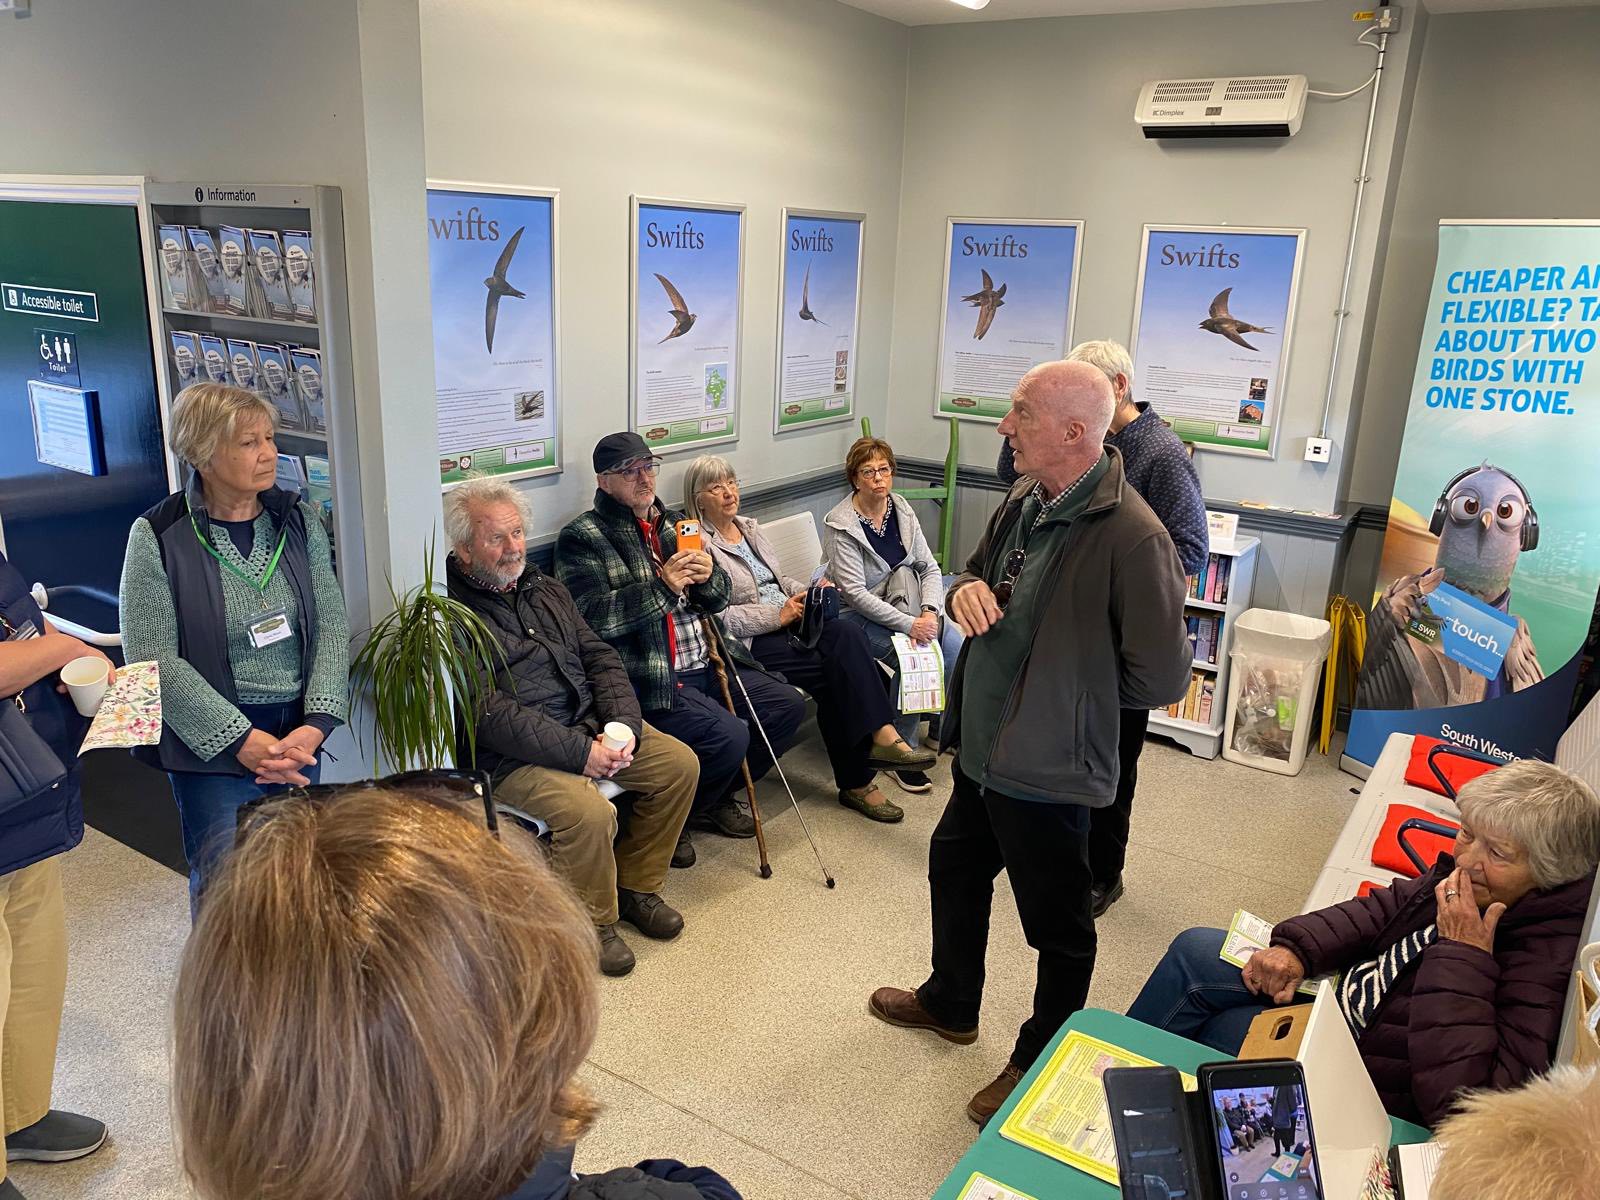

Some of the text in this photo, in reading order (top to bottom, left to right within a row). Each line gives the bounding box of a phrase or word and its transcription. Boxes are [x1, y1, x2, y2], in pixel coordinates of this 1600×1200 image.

[1159, 109, 1185, 117] Dimplex
[207, 187, 257, 202] Information
[427, 206, 500, 242] wifts
[646, 220, 705, 250] Swifts
[791, 227, 834, 253] Swifts
[962, 234, 1029, 259] Swifts
[1160, 242, 1240, 269] Swifts
[1446, 265, 1566, 295] CHEAPER
[21, 292, 85, 314] Accessible toilet
[1440, 297, 1573, 324] FLEXIBLE?
[1434, 328, 1597, 353] ABOUT TWO
[48, 361, 68, 373] Toilet
[1430, 358, 1585, 385] BIRDS WITH
[1425, 386, 1575, 415] ONE STONE.
[1417, 623, 1436, 638] SWR
[1440, 723, 1479, 750] South
